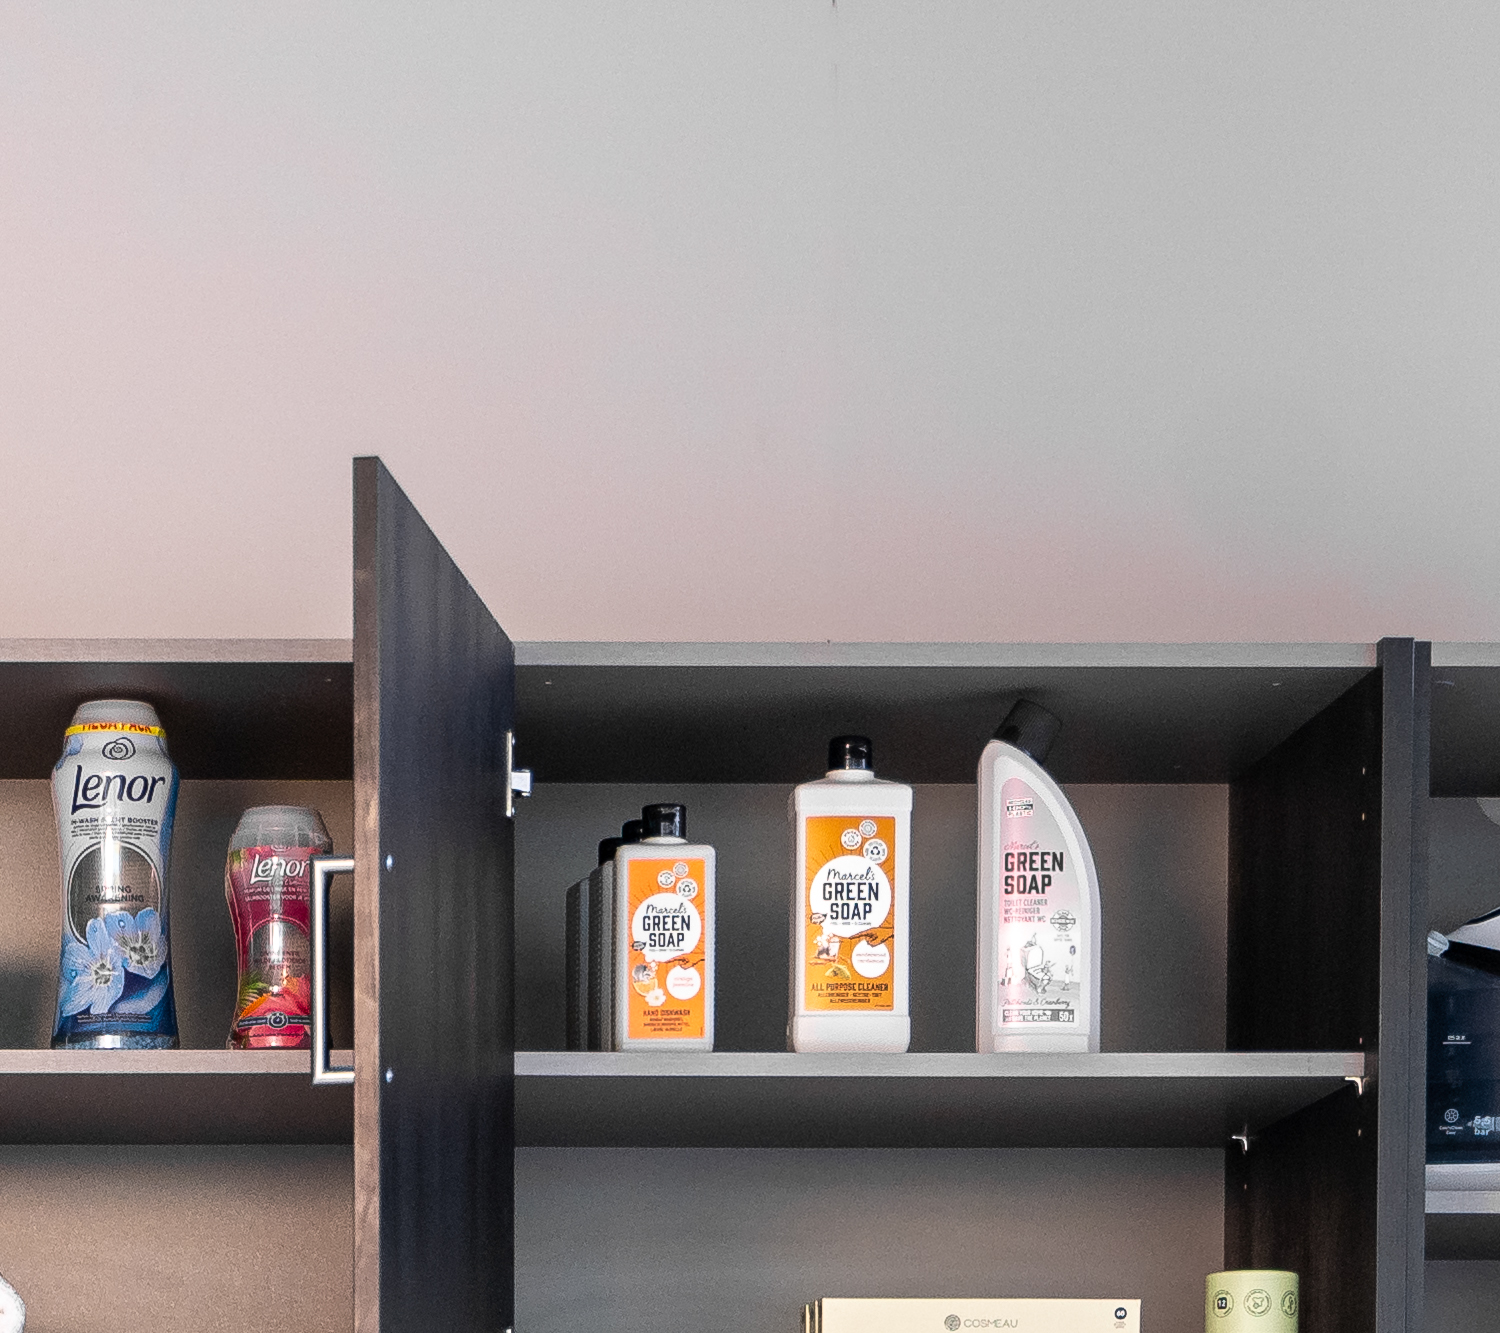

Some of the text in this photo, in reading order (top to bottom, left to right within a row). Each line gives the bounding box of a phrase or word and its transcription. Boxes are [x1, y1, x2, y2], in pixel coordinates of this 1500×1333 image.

[71, 765, 166, 815] Lenor
[127, 816, 159, 826] BOOSTER
[250, 854, 310, 884] Lenor
[1004, 851, 1064, 873] GREEN
[827, 866, 876, 882] Marcel's
[822, 882, 879, 901] GREEN
[1004, 874, 1052, 895] SOAP
[646, 902, 688, 915] Marcel's
[1024, 898, 1048, 907] CLEANER
[830, 902, 873, 920] SOAP
[642, 915, 691, 932] GREEN
[648, 932, 685, 948] SOAP
[811, 982, 825, 992] ALL
[858, 982, 889, 992] CLEANER
[1474, 1127, 1489, 1136] bar
[963, 1319, 1019, 1329] COSMEAU
